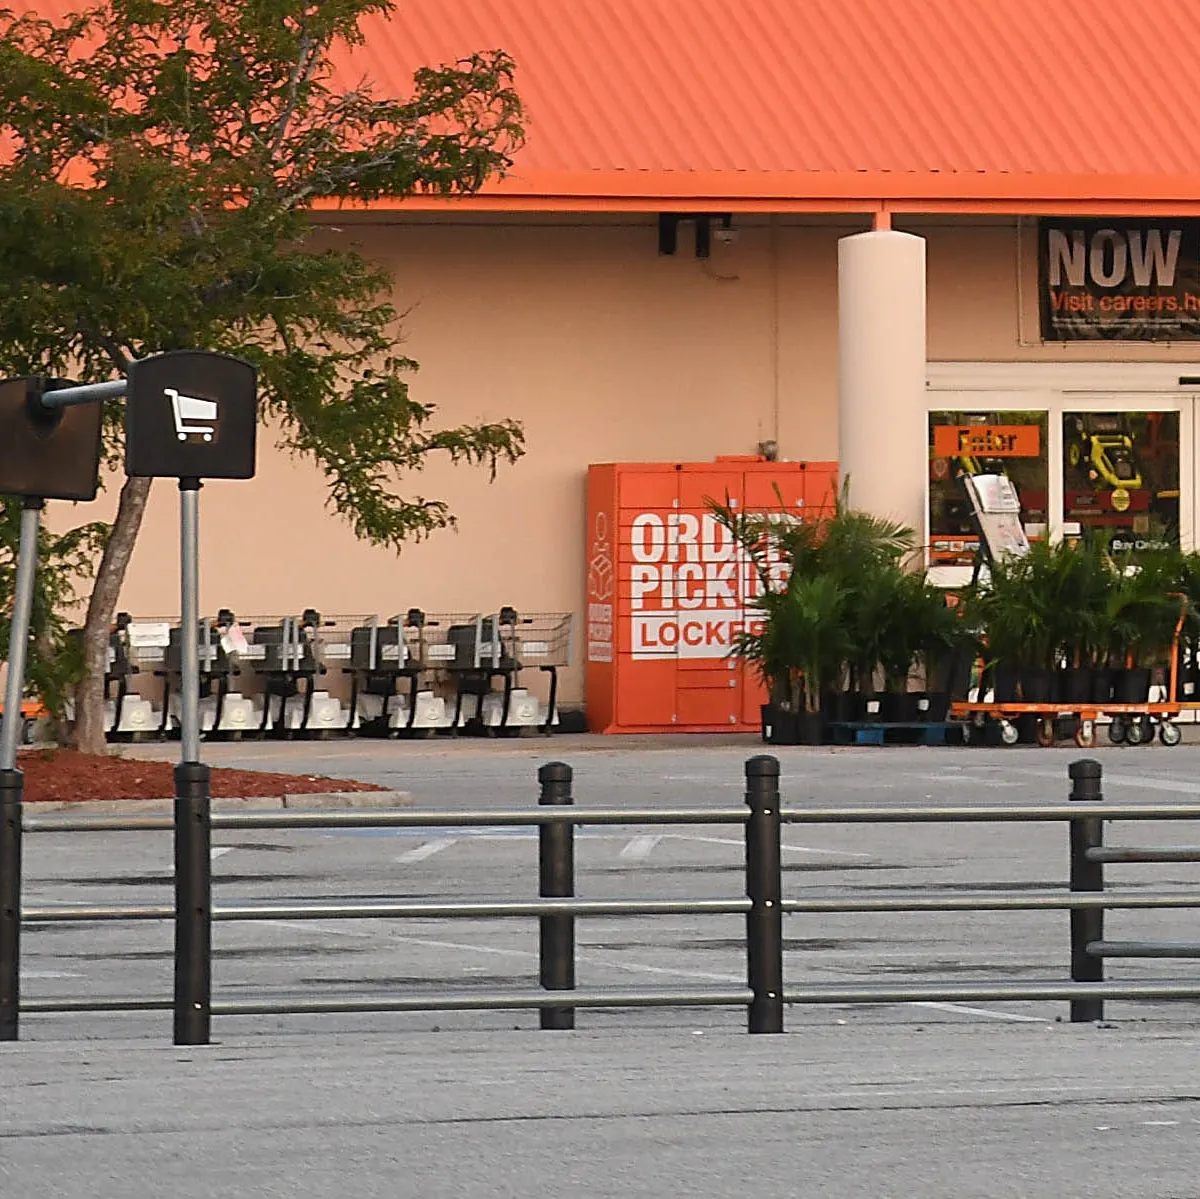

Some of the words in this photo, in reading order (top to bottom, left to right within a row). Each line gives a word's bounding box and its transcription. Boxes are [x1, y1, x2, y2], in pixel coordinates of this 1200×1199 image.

[1048, 228, 1182, 287] NOW
[1051, 291, 1094, 312] Visit
[957, 429, 1017, 451] Enter
